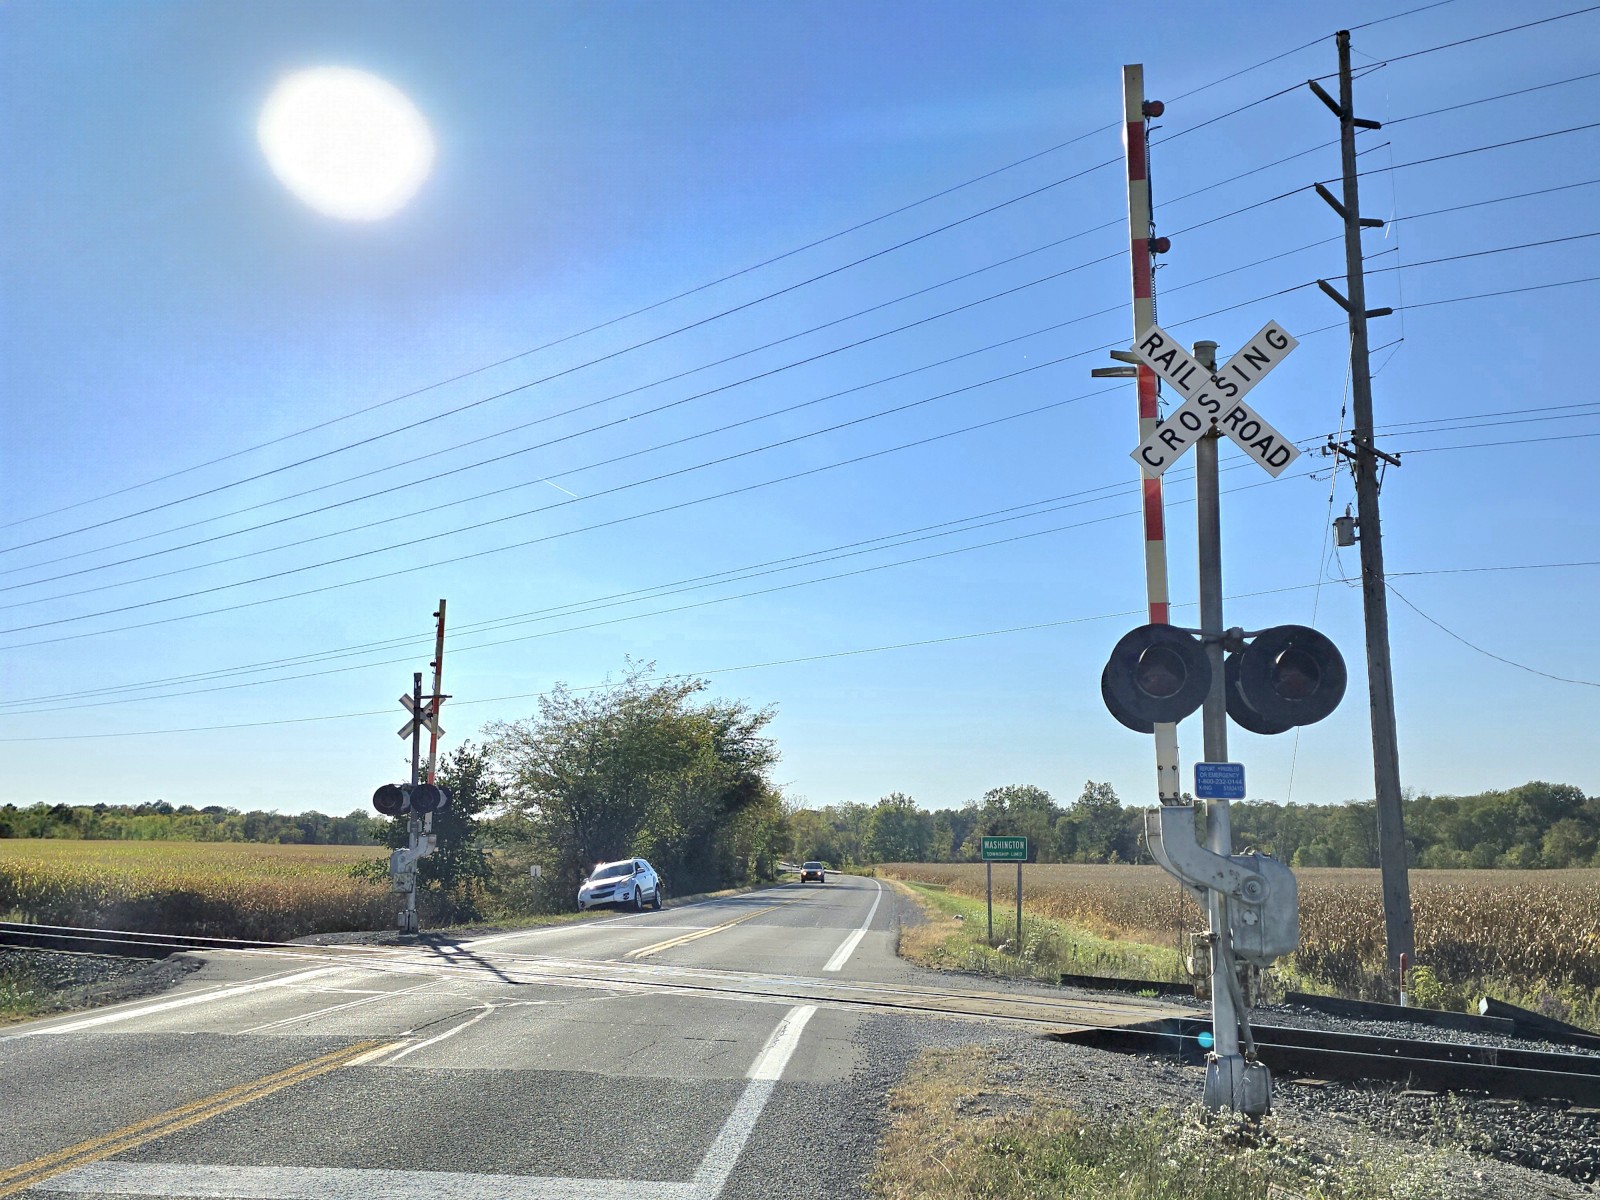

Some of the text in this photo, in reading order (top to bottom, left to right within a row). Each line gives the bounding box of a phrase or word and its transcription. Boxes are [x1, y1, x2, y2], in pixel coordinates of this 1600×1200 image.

[1139, 331, 1291, 468] RAIL ROAD
[1141, 328, 1288, 467] CROSSING
[984, 840, 1025, 849] WASHINGTON
